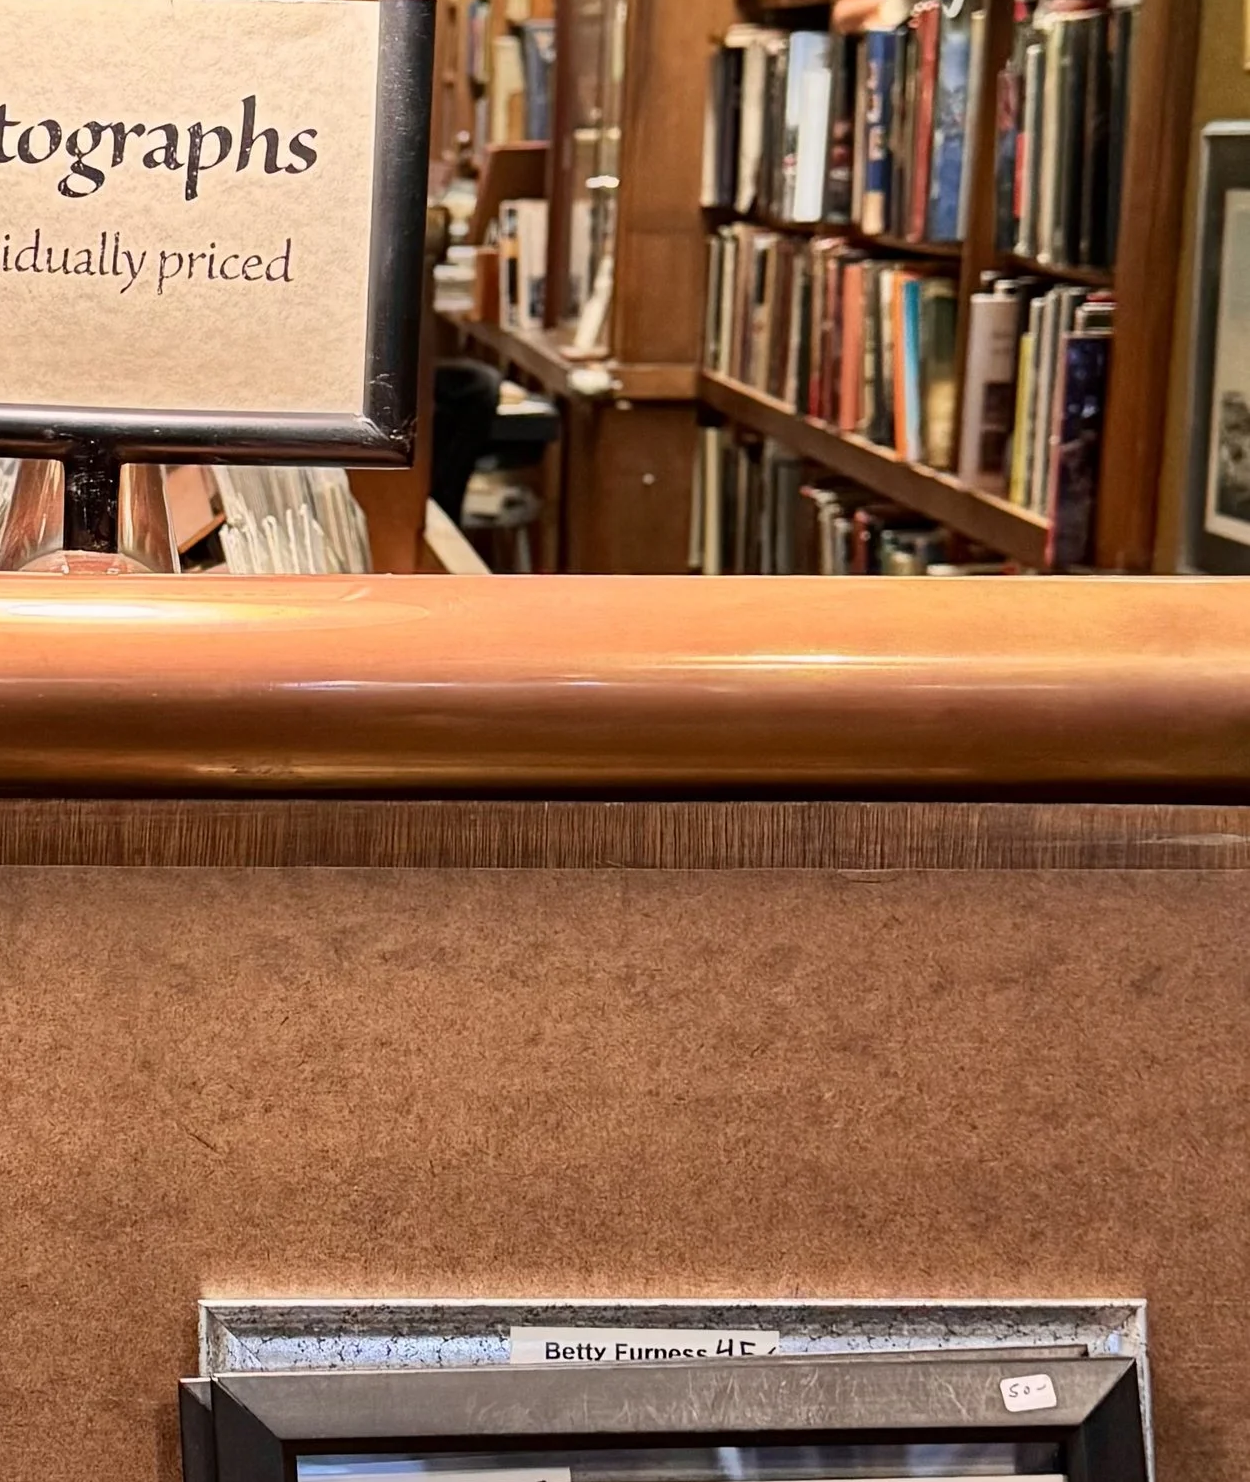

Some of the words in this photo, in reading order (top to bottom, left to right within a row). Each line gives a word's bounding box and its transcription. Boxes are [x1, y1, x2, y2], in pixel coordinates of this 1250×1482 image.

[157, 239, 293, 295] priced
[545, 1341, 606, 1360] Betty
[615, 1343, 707, 1360] Furness
